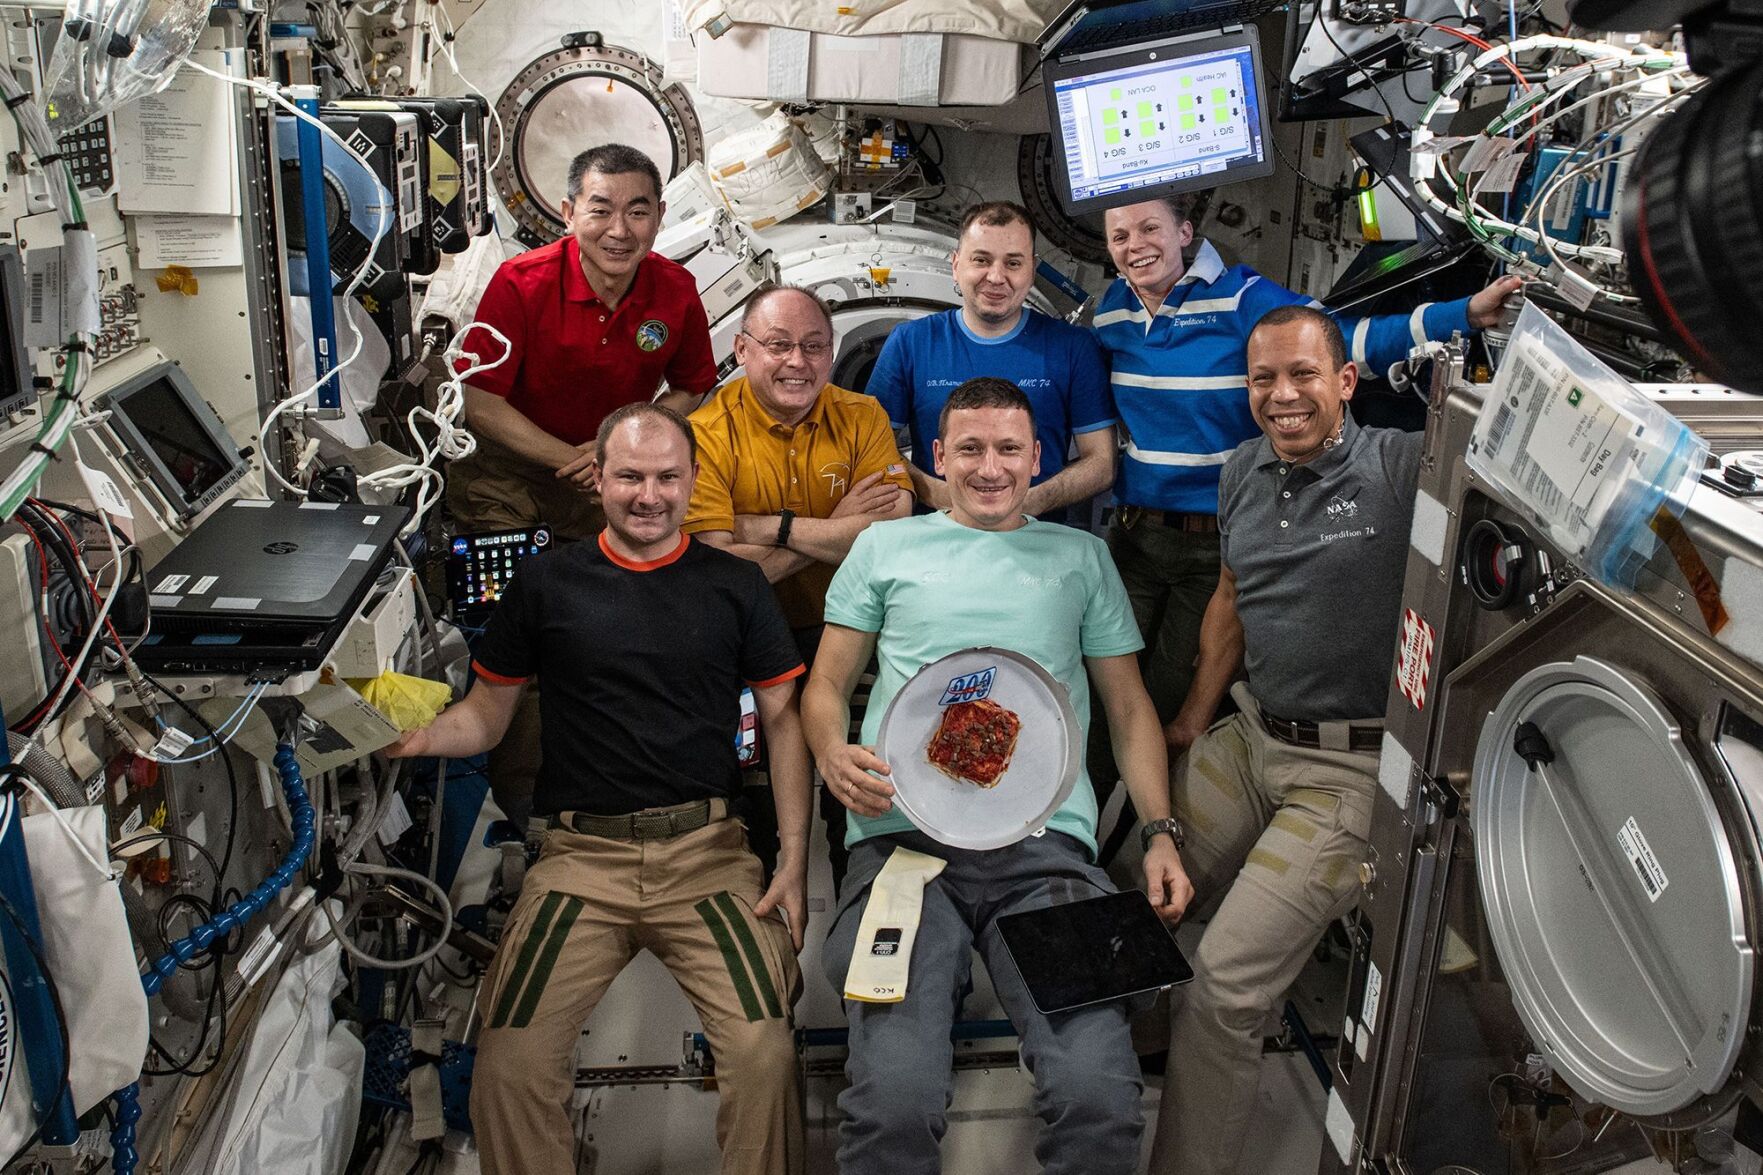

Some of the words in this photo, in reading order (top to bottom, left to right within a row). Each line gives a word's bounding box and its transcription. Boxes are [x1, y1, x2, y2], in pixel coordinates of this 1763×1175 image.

[1197, 73, 1214, 82] Health
[1128, 87, 1141, 96] LAN
[1142, 85, 1156, 93] OCA
[1219, 126, 1234, 136] S/G
[1179, 135, 1184, 144] 2
[1186, 132, 1201, 142] S/G
[1138, 143, 1144, 151] 3
[1145, 141, 1161, 151] S/G
[1198, 144, 1220, 153] S-Band
[1104, 150, 1109, 158] 4
[1111, 147, 1126, 157] S/G
[1122, 159, 1148, 169] Ku-Band
[1174, 317, 1205, 328] Expedition
[1207, 315, 1217, 324] 74
[1039, 379, 1051, 387] 74
[1598, 449, 1612, 464] Day
[1590, 462, 1604, 477] Bag
[1327, 500, 1357, 514] NASA
[1320, 530, 1361, 542] Expedition
[1365, 526, 1375, 535] 74
[1412, 627, 1421, 655] FIRE
[1417, 633, 1426, 677] EMERGENCY
[1408, 656, 1417, 690] PORT
[946, 671, 992, 703] 200
[1635, 831, 1646, 851] Glove
[1646, 851, 1655, 868] Ring
[1655, 868, 1664, 885] Plug
